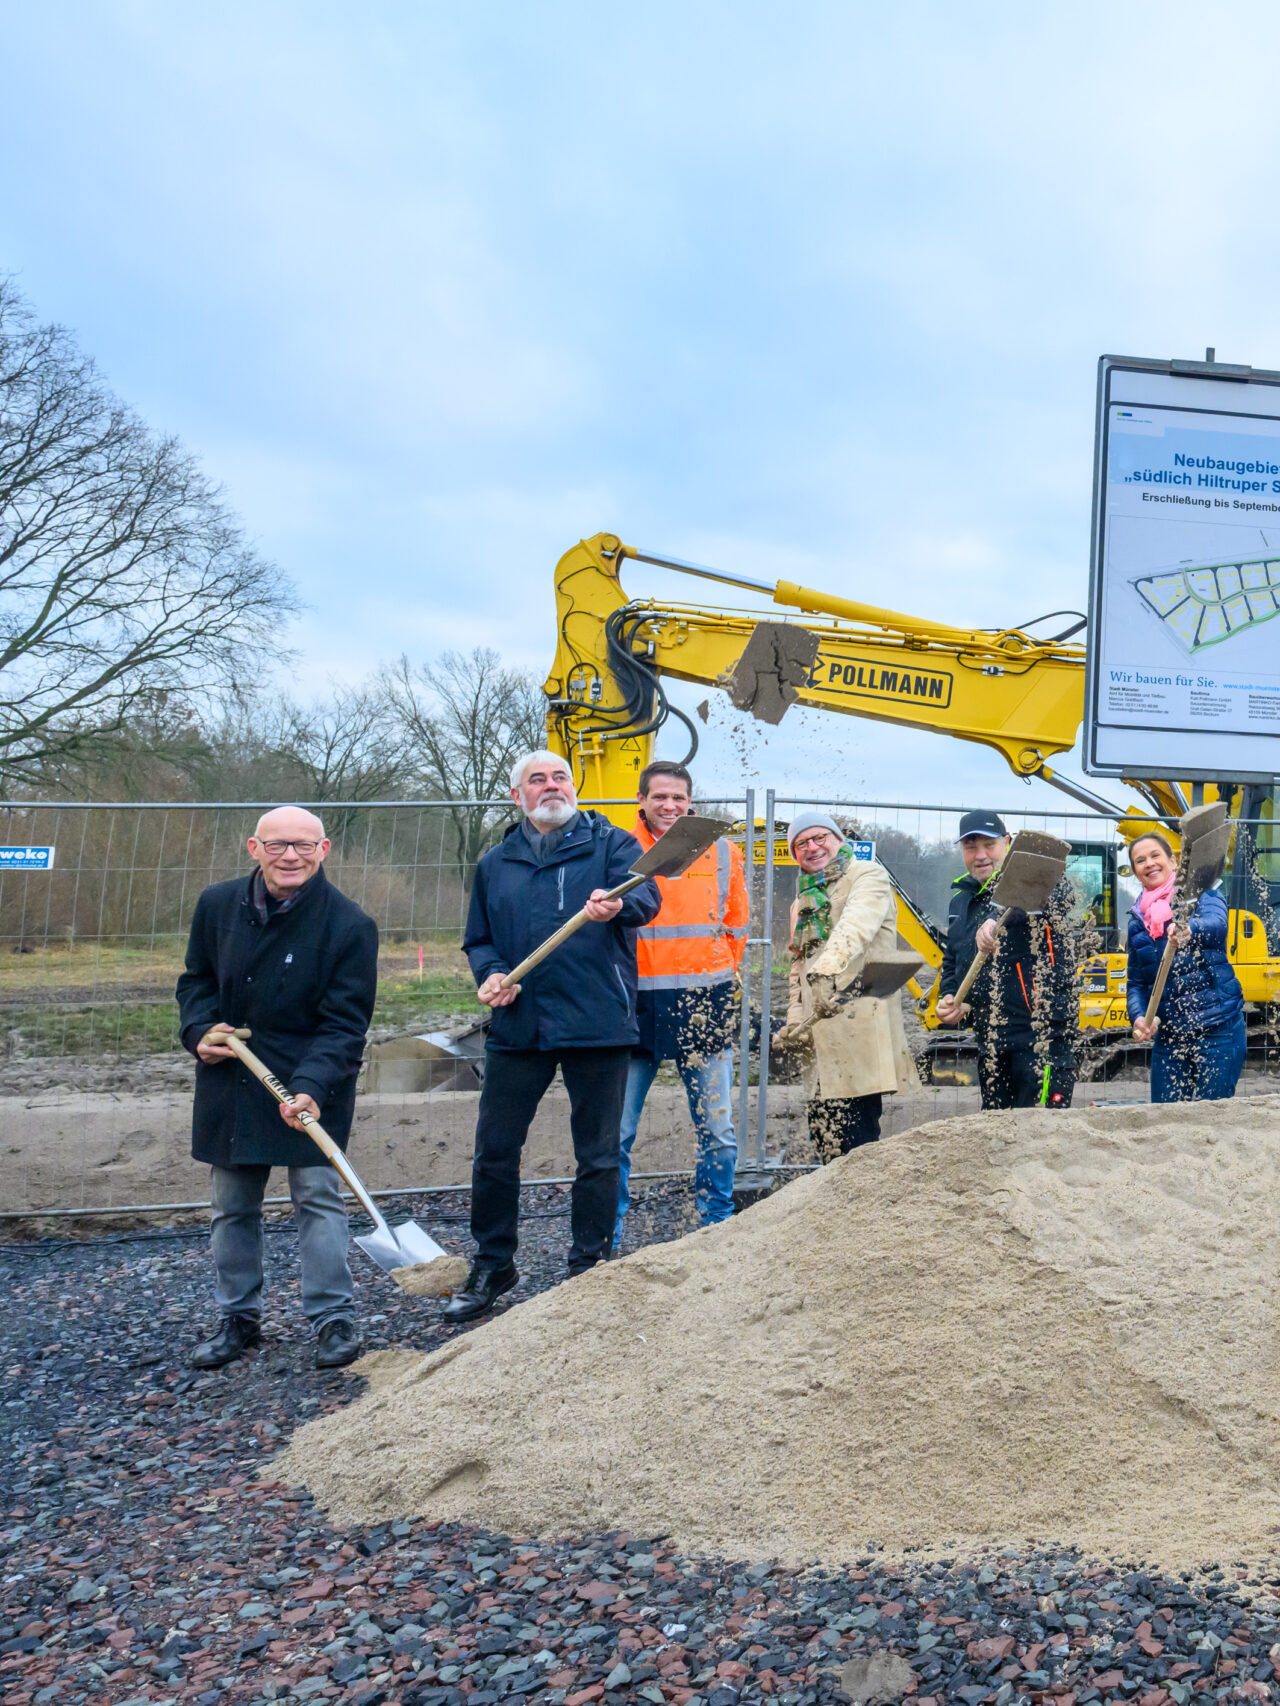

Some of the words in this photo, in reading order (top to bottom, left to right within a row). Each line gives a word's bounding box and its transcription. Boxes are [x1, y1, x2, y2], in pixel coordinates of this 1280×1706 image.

[1124, 469, 1192, 486] „südlich
[1197, 473, 1268, 493] Hiltruper
[1142, 492, 1211, 508] Erschließung
[1214, 498, 1230, 508] bis
[828, 662, 943, 699] POLLMANN
[1109, 671, 1132, 682] Wir
[1136, 672, 1172, 685] bauen
[1175, 675, 1193, 686] für
[1196, 676, 1218, 688] Sie.
[0, 848, 48, 860] weko
